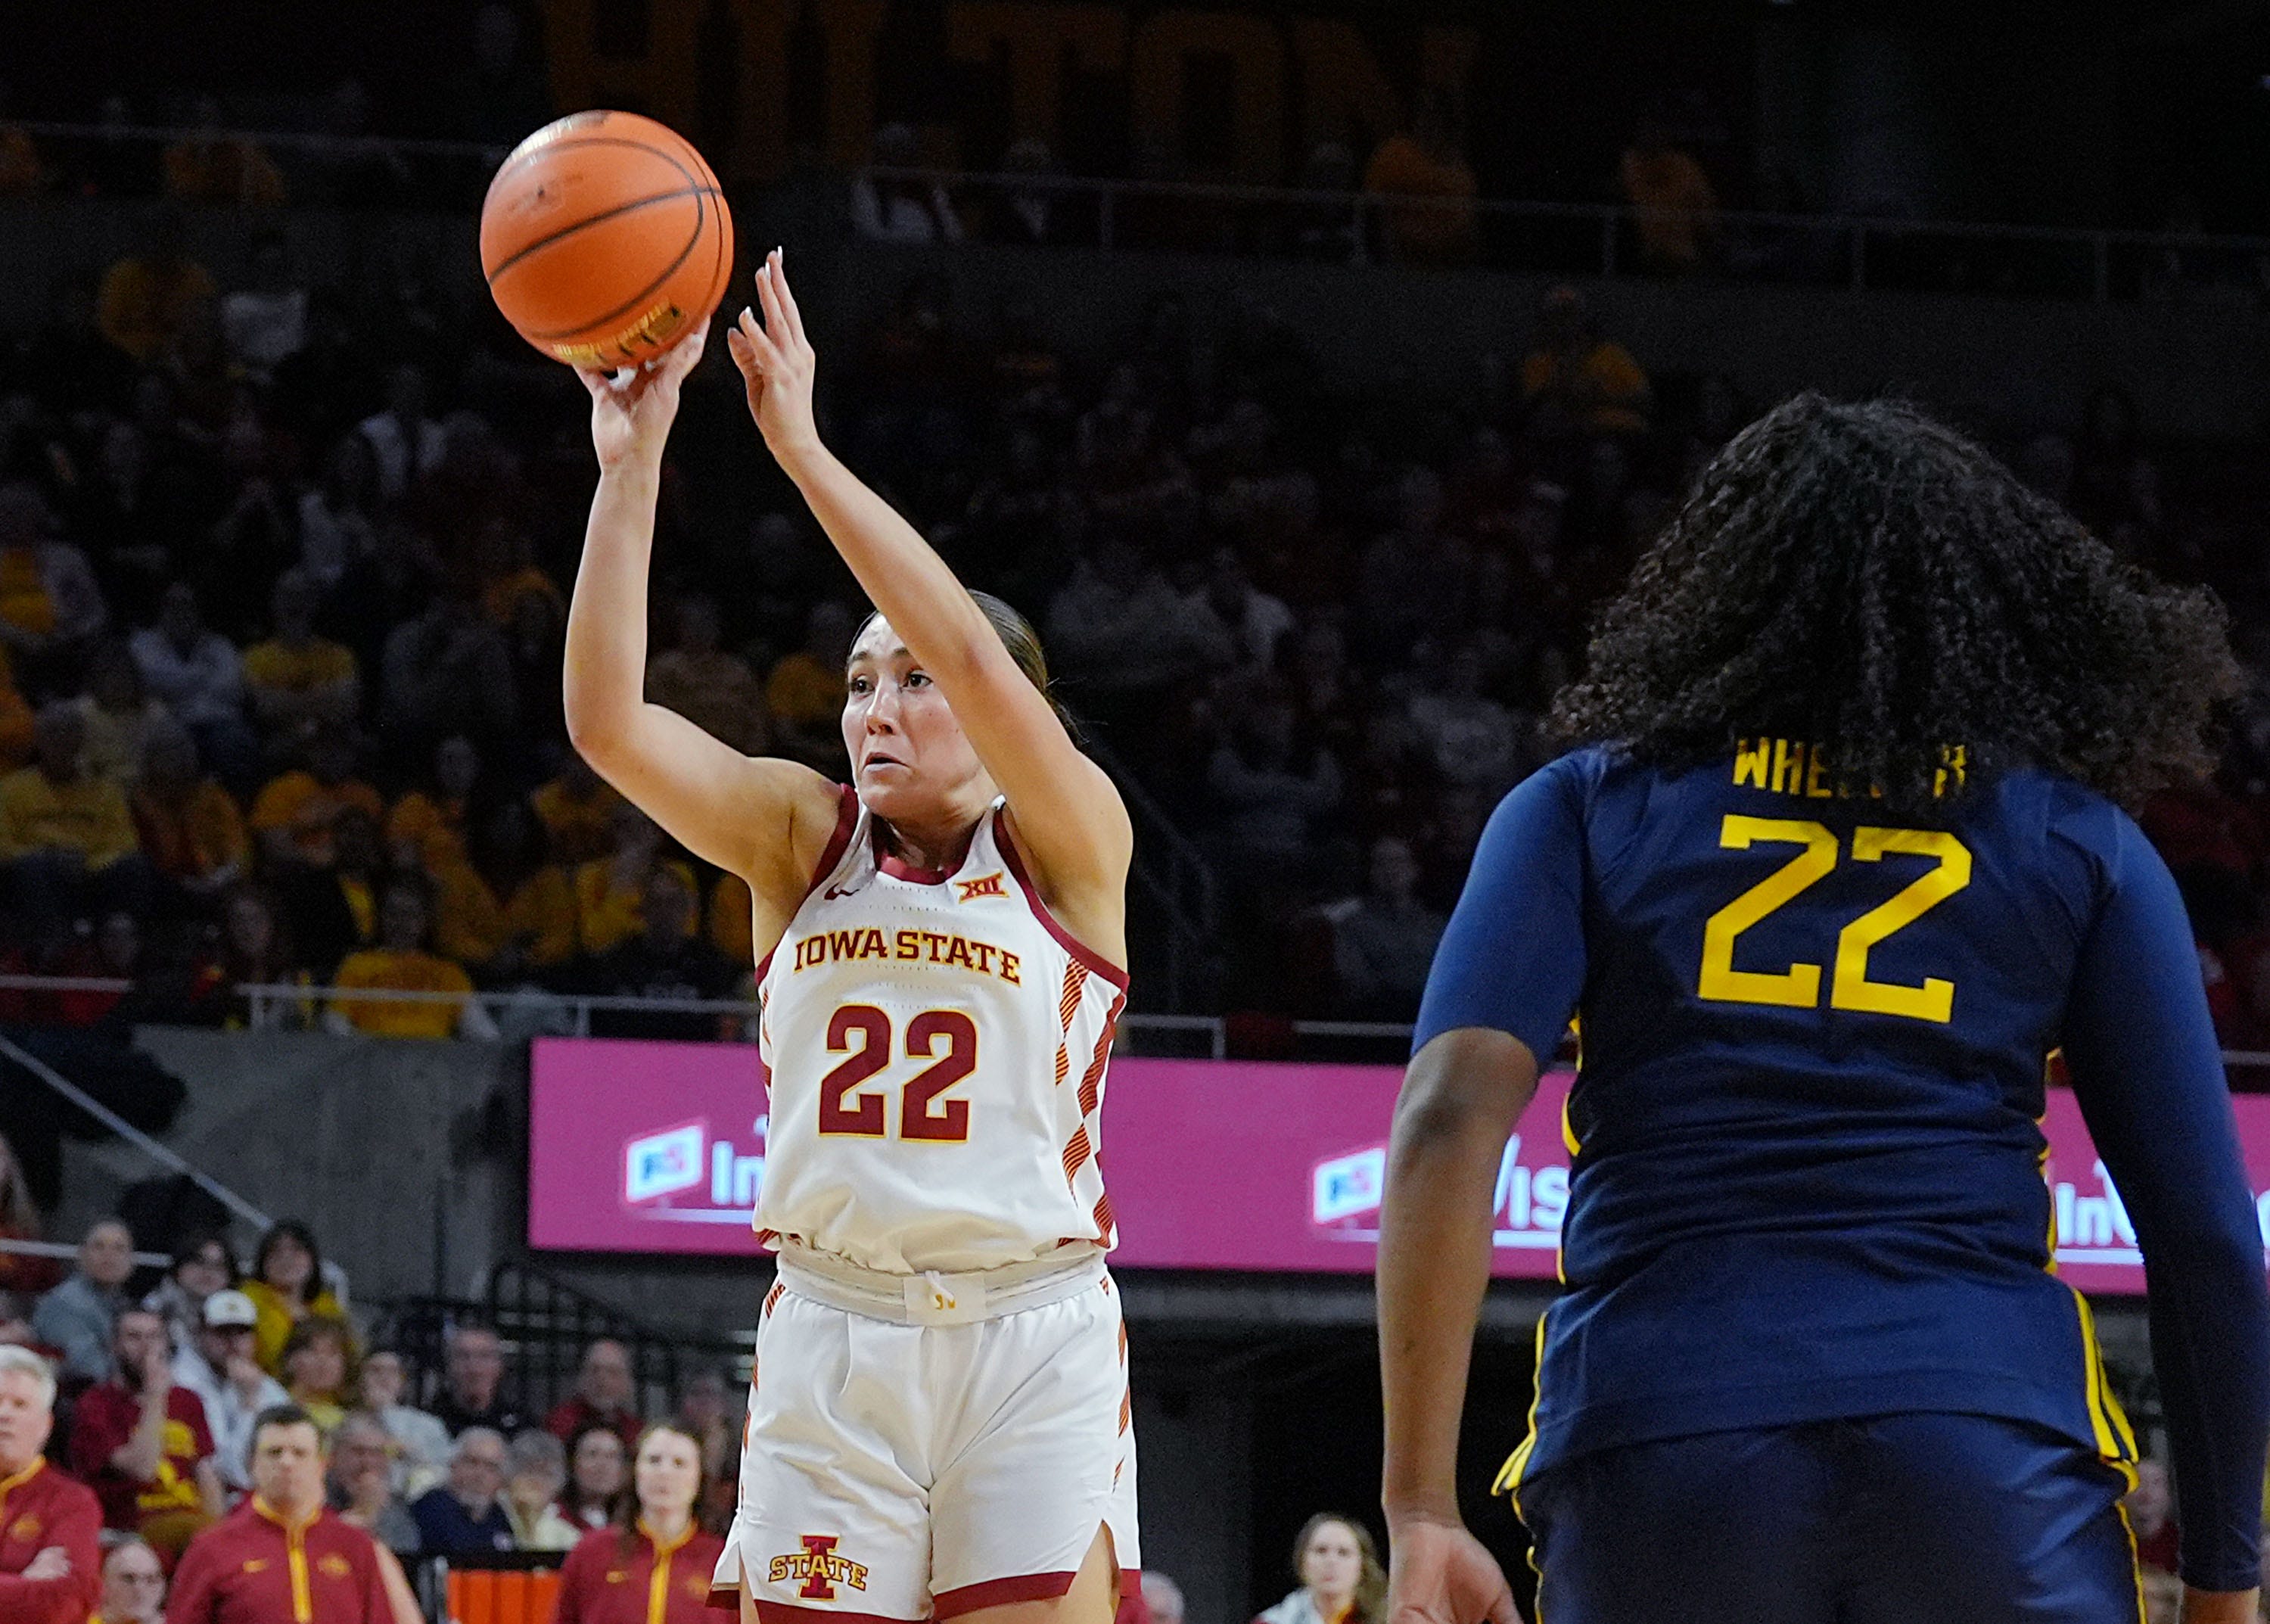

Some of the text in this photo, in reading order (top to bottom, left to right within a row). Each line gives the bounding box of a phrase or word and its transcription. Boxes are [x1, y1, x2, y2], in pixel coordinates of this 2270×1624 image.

[1732, 737, 1967, 798] WHER
[1698, 814, 1973, 1024] 22
[792, 929, 1022, 987] IOWA STATE
[819, 1003, 978, 1144] 22
[768, 1554, 869, 1591] STATE
